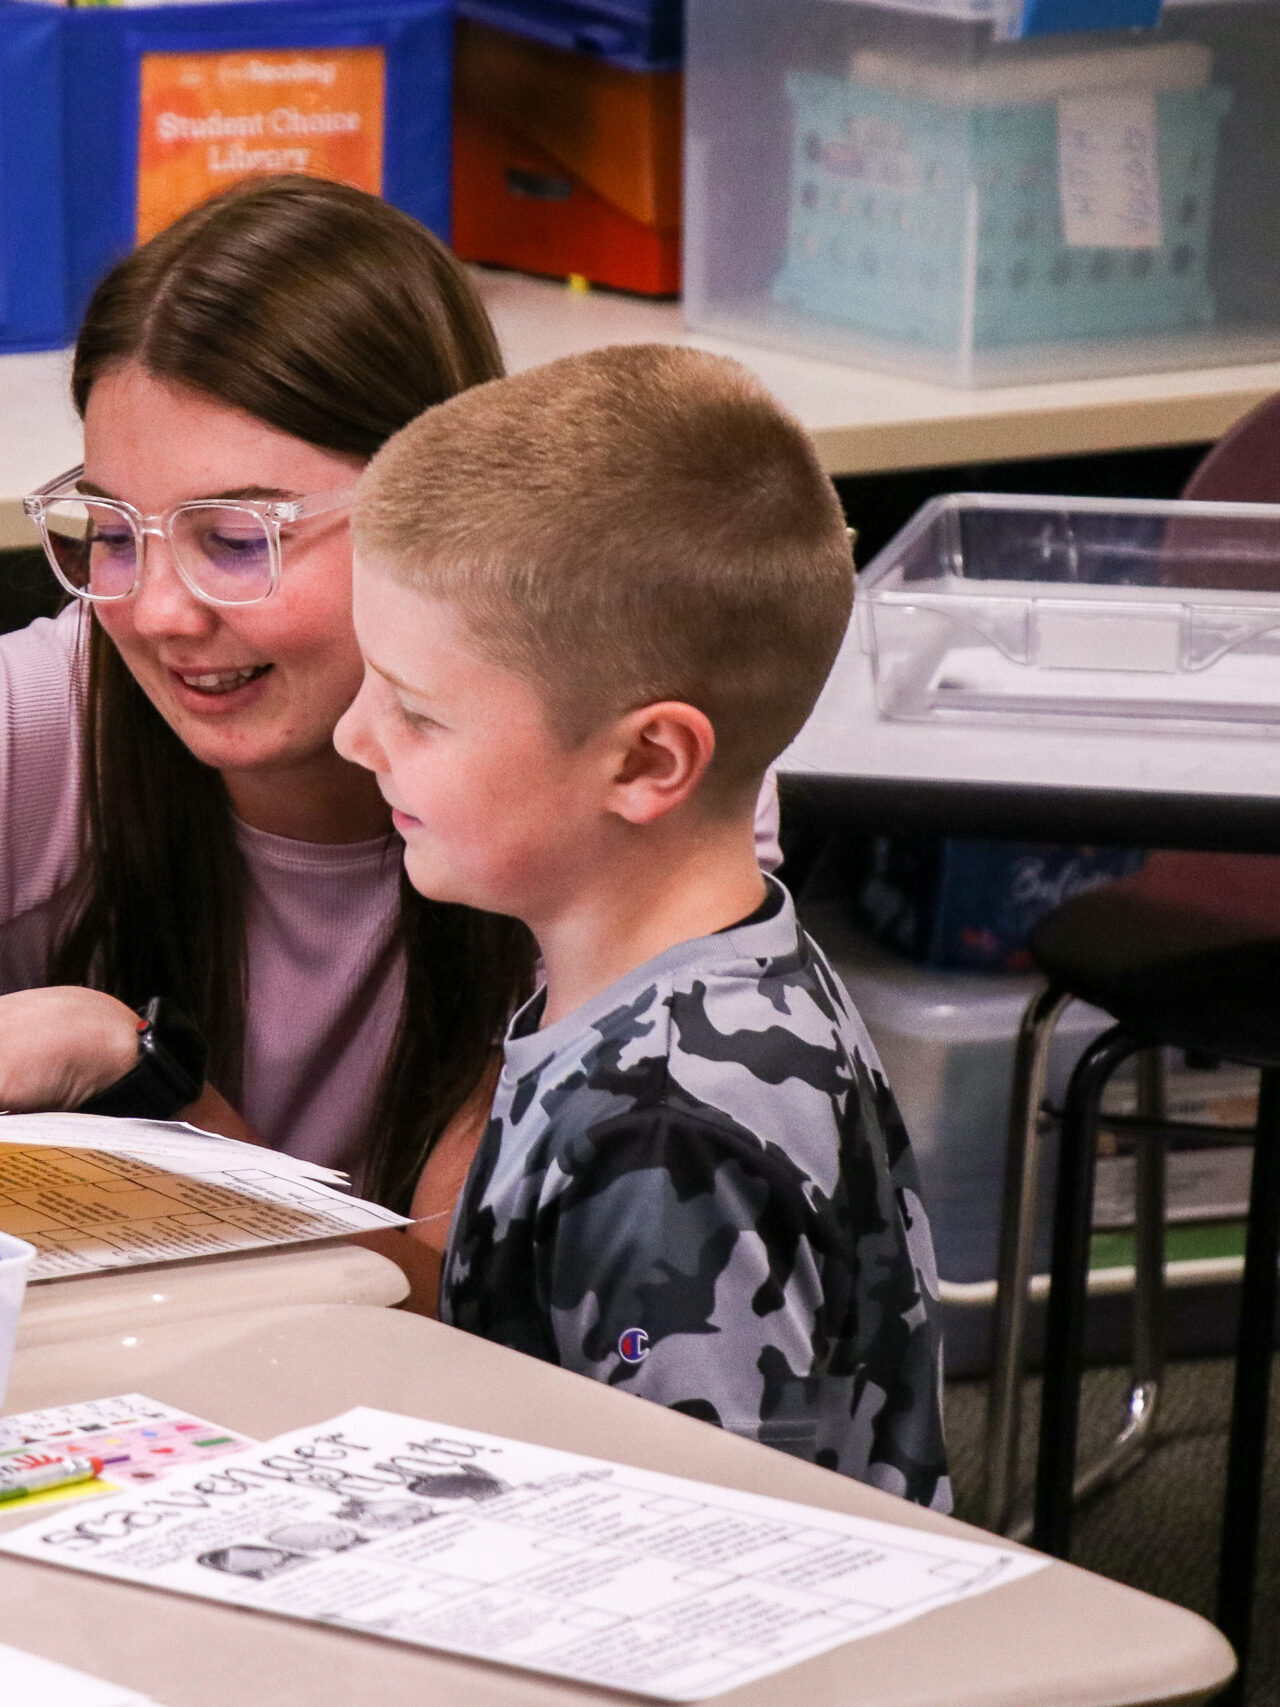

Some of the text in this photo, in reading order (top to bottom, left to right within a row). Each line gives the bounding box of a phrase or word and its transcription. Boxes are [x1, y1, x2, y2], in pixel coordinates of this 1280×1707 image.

[156, 106, 361, 142] Student Choice
[207, 142, 312, 173] Library
